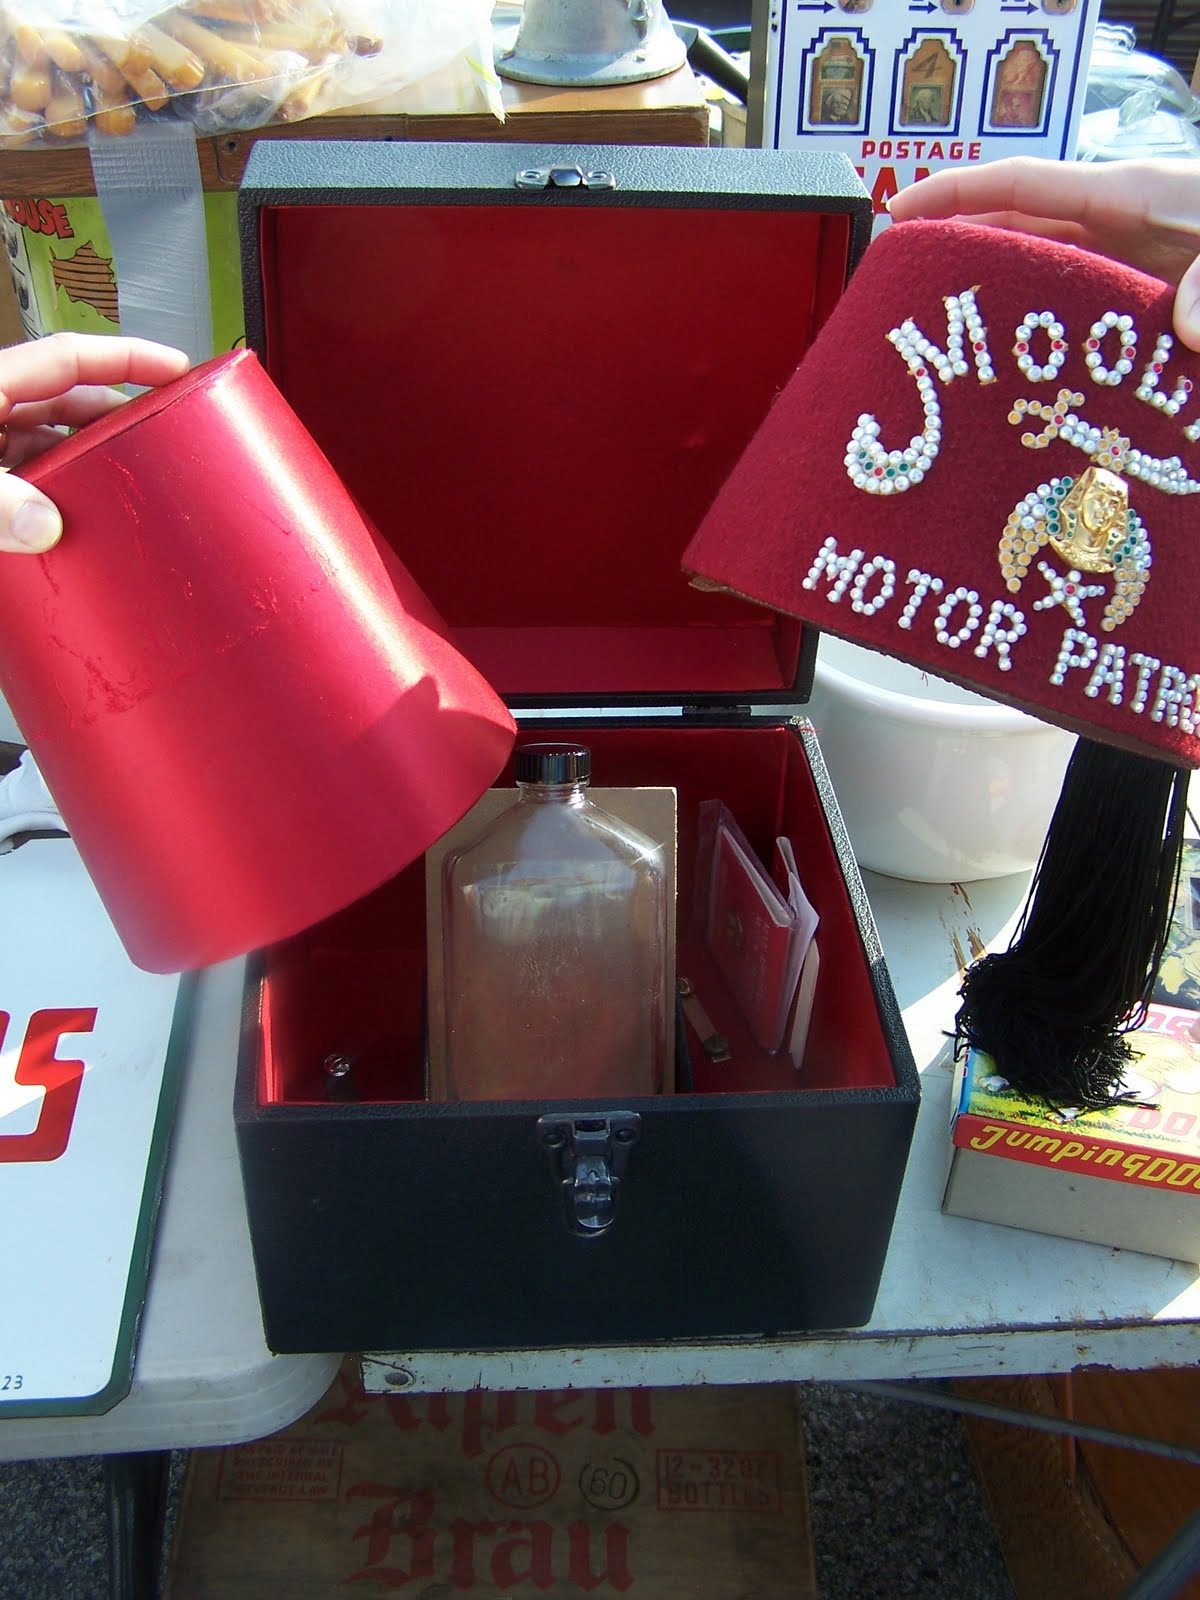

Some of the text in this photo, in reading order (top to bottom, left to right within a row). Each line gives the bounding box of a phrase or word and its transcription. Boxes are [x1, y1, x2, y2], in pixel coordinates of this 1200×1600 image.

[862, 140, 982, 160] POSTAGE
[4, 199, 75, 239] OUSE
[802, 536, 1200, 734] MOTOR PATRO
[1129, 1106, 1200, 1137] DO
[501, 1457, 550, 1497] AB
[340, 1482, 635, 1592] Brau
